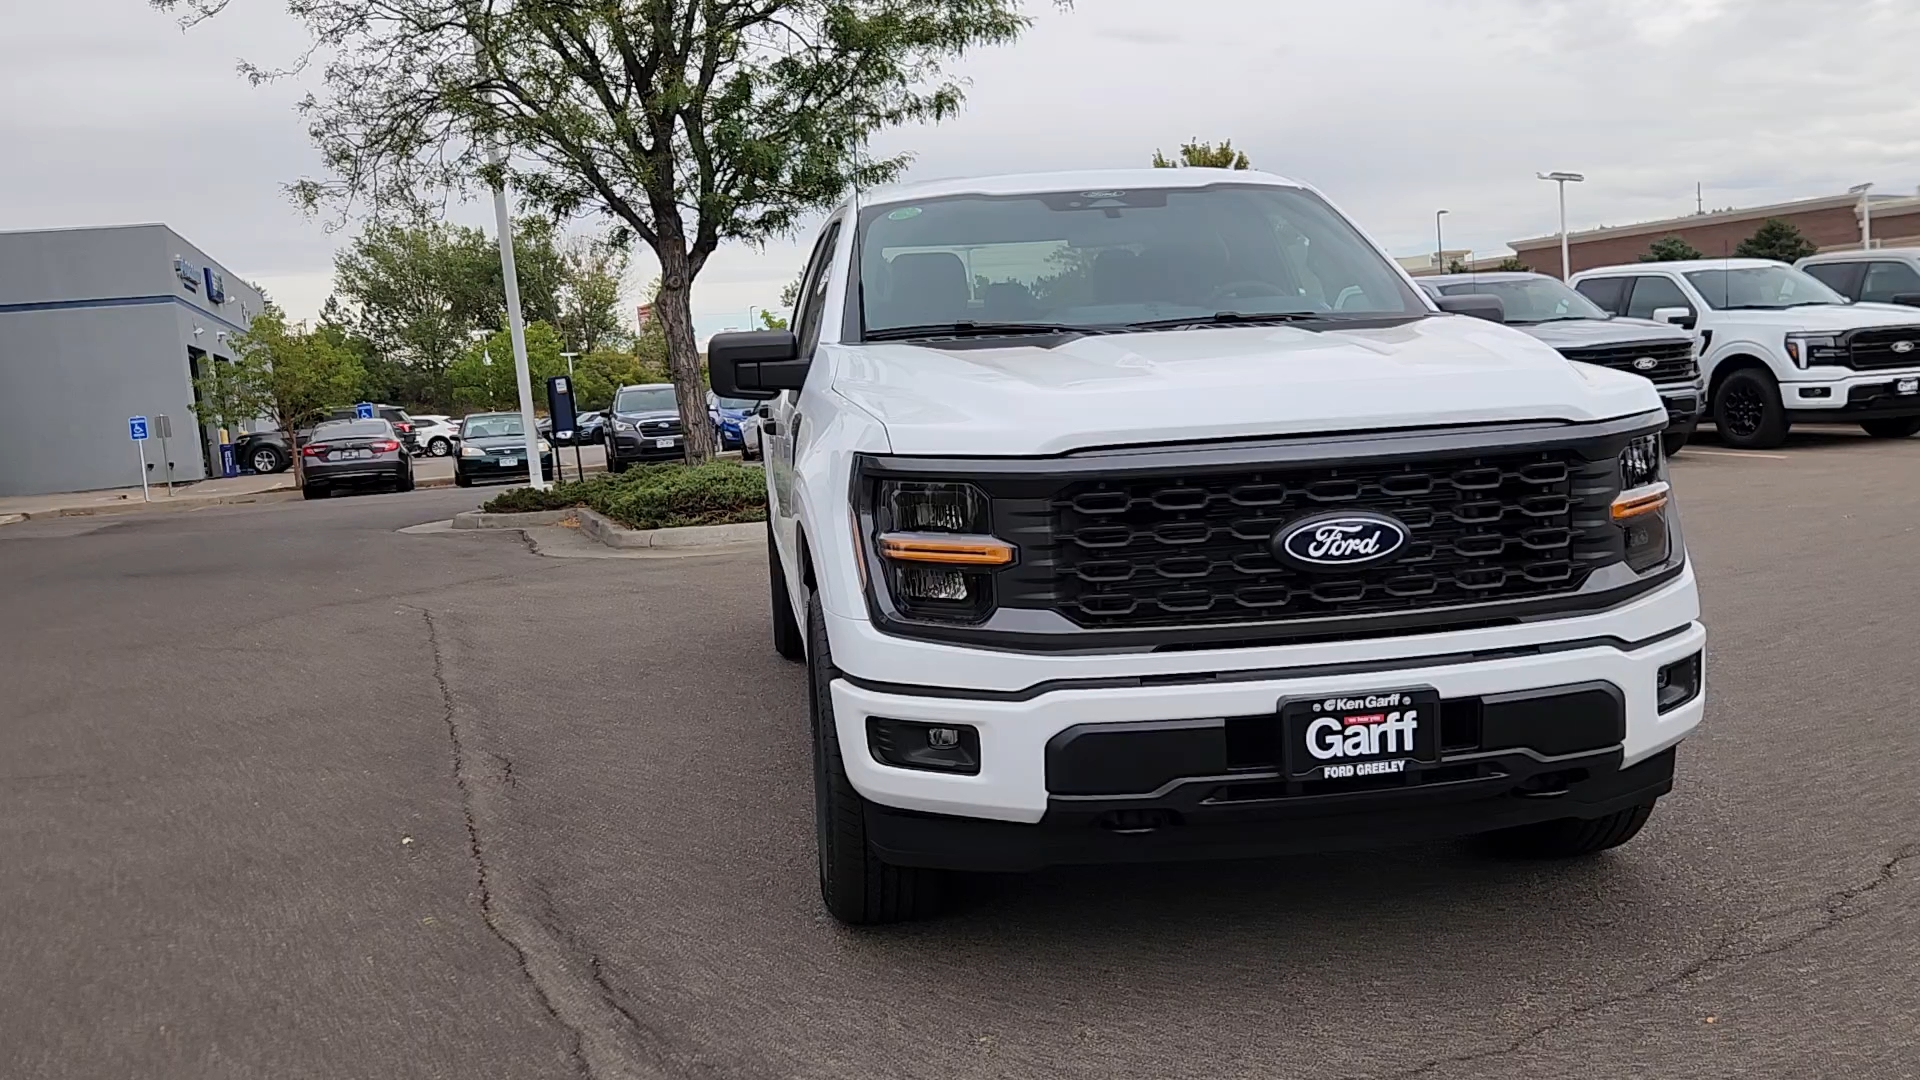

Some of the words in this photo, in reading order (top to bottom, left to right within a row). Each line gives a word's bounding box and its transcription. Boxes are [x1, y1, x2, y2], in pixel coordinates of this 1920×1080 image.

[1308, 524, 1381, 557] Ford
[1336, 698, 1364, 711] Ken
[1365, 693, 1400, 709] Garff
[1305, 710, 1418, 760] Garff
[1324, 765, 1354, 779] FORD
[1356, 760, 1405, 776] GREELEY
